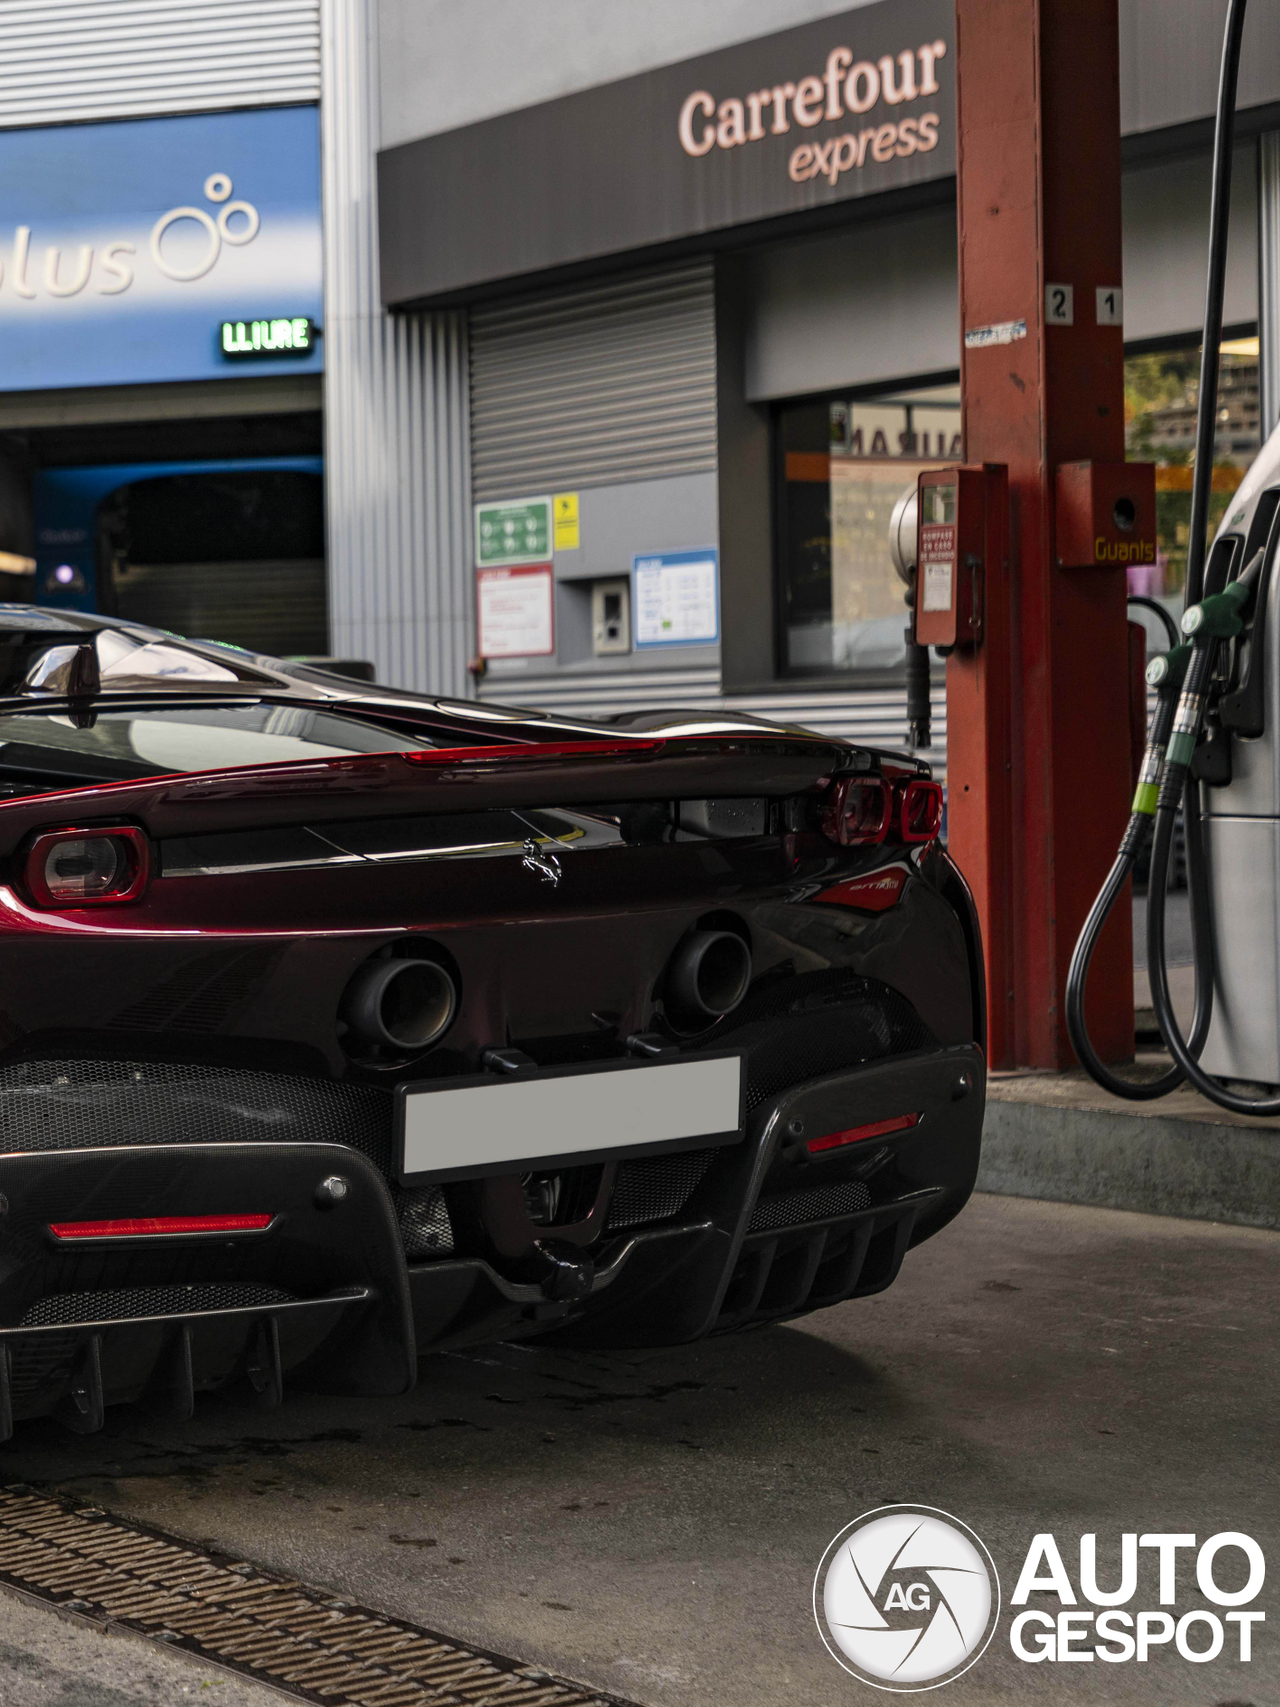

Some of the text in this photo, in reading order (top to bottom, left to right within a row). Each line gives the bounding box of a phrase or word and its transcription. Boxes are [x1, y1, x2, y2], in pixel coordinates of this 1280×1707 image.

[678, 39, 946, 157] Carrefour
[788, 112, 940, 185] express
[1052, 288, 1067, 318] 2
[1104, 291, 1115, 317] 1
[222, 318, 309, 352] LLIURE
[934, 541, 952, 551] CASO
[1095, 536, 1154, 562] Guants
